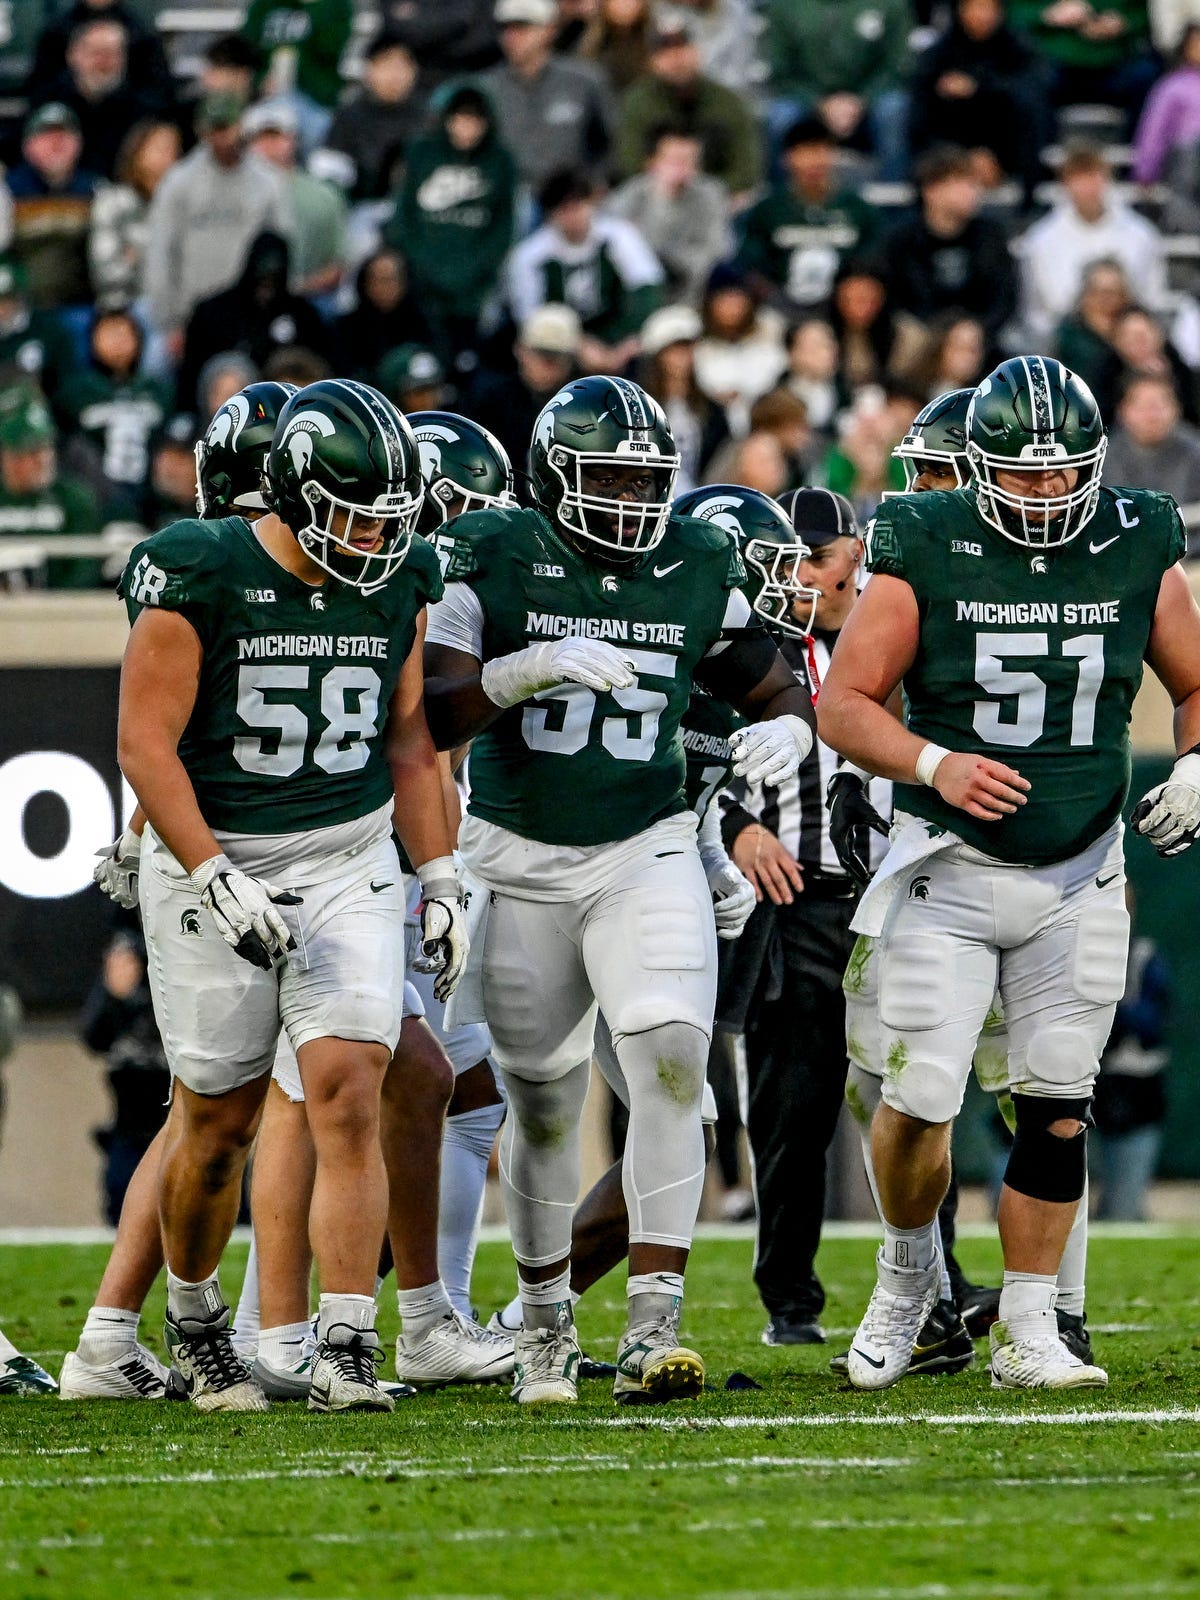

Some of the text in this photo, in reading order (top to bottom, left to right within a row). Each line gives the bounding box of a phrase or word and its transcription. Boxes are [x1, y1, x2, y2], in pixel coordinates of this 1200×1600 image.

[629, 442, 652, 453] STATE
[1032, 447, 1057, 457] STATE
[1114, 498, 1140, 529] C
[129, 553, 168, 605] 58
[524, 610, 687, 648] MICHIGAN STATE
[955, 599, 1121, 625] MICHIGAN STATE
[236, 635, 389, 660] MICHIGAN STATE
[971, 632, 1106, 748] 51
[231, 664, 383, 778] 58
[117, 1358, 167, 1396] NIKE
